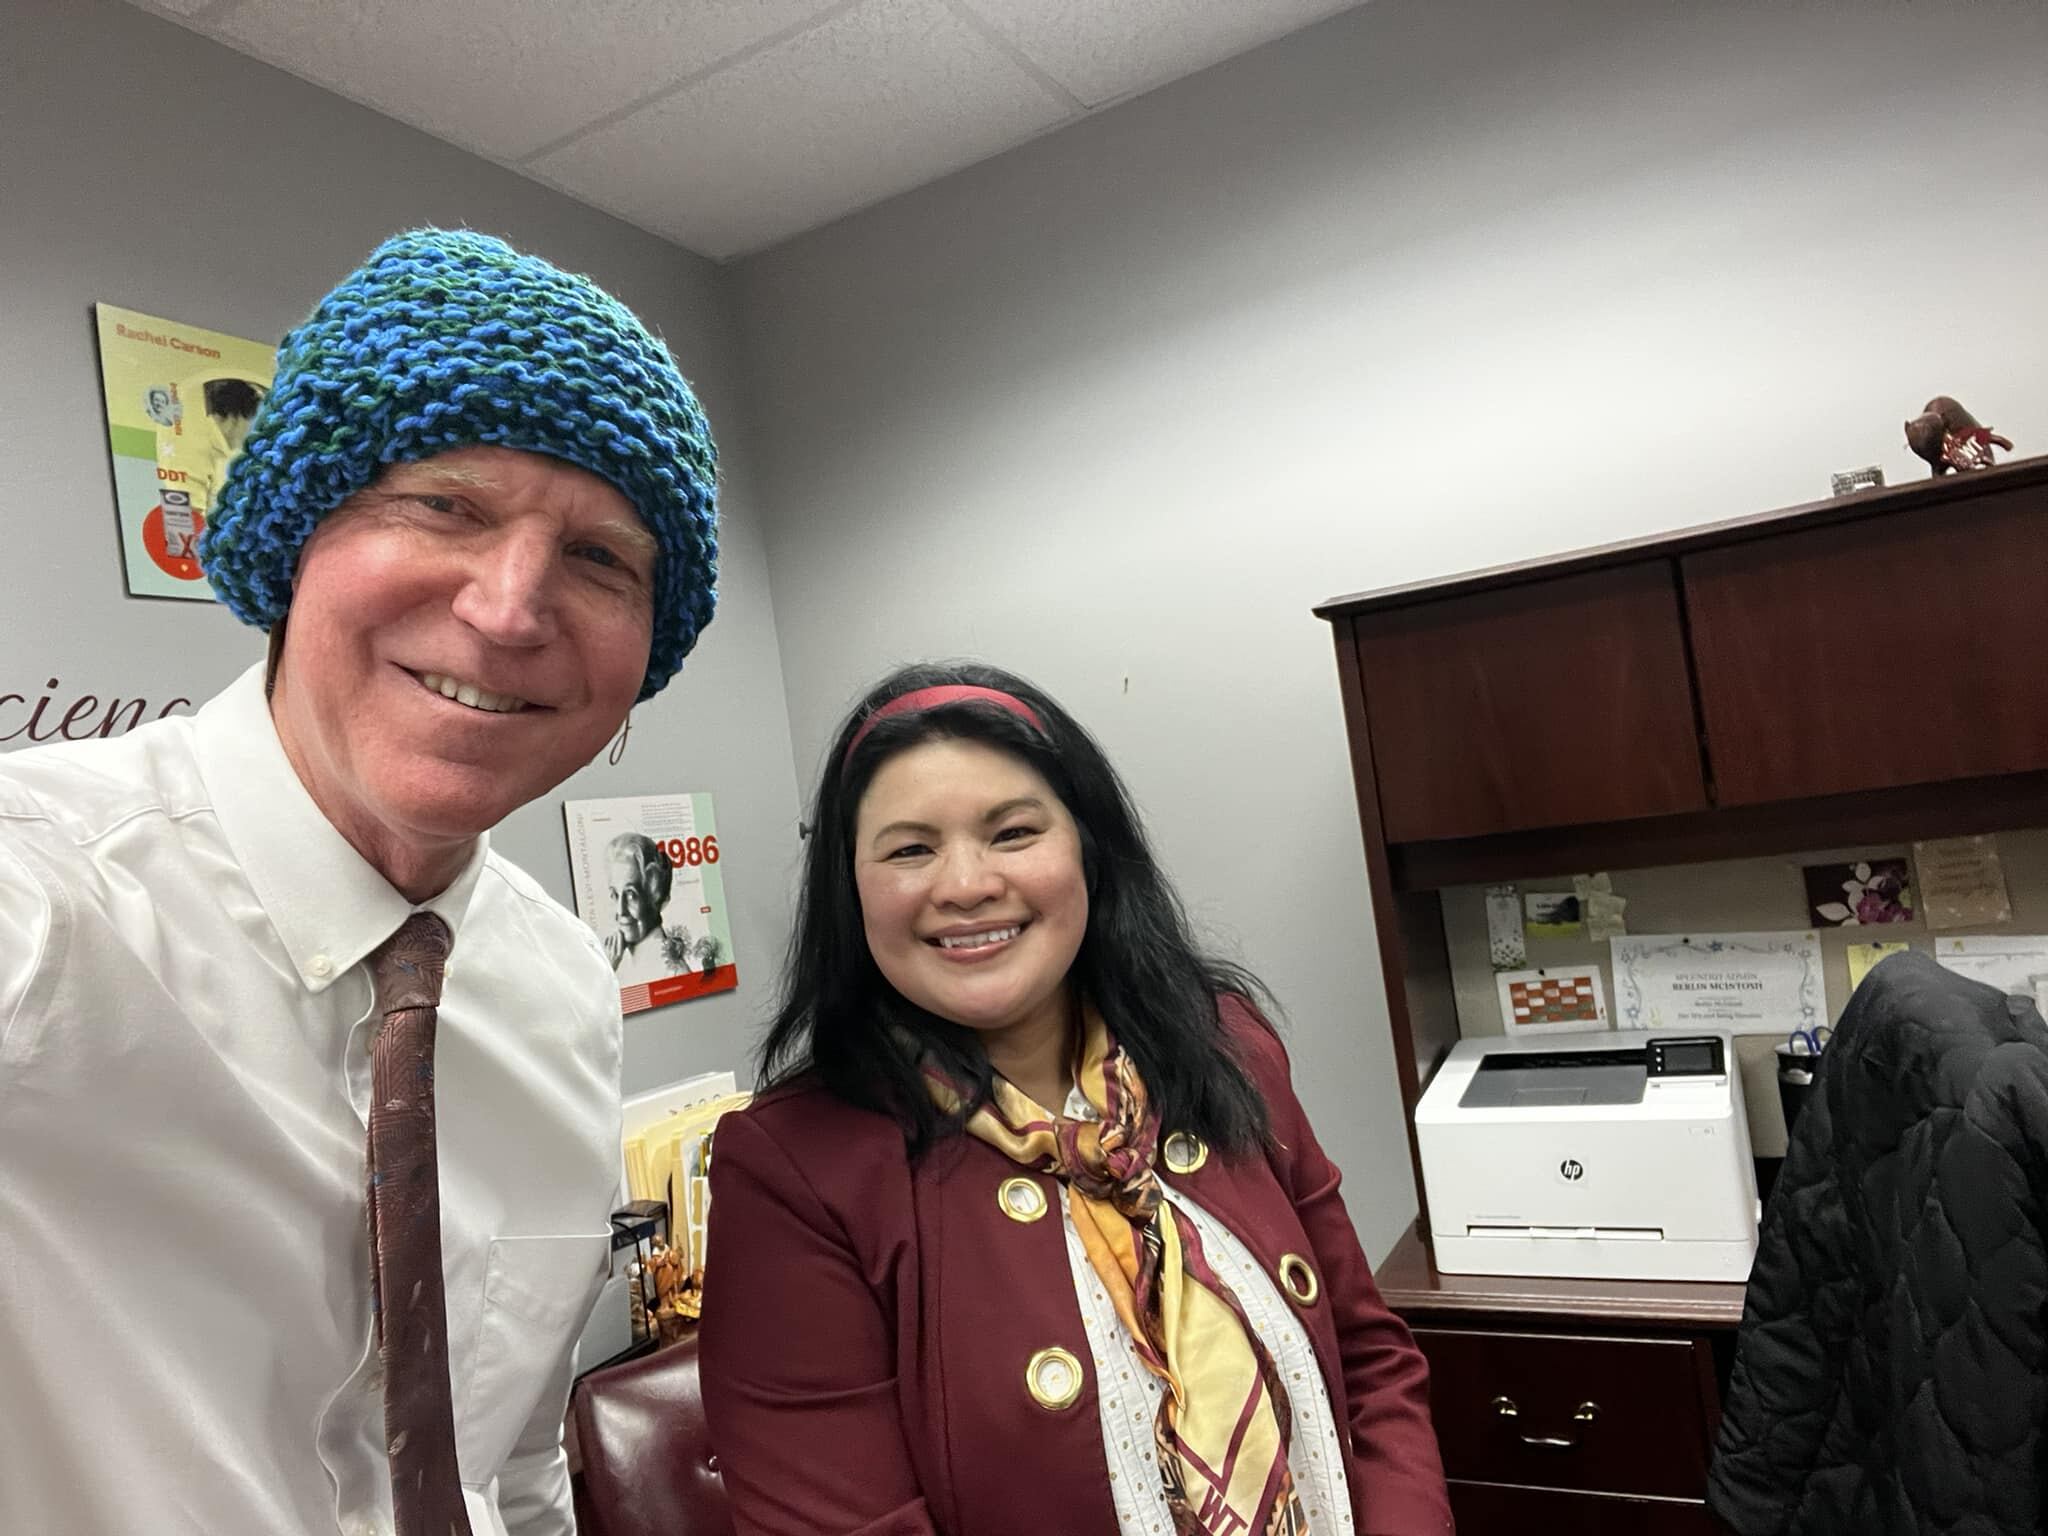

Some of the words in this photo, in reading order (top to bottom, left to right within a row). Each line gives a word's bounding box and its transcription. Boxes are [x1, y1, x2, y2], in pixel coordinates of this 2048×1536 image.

[116, 323, 167, 347] Rachel
[170, 338, 221, 359] Carson
[156, 467, 188, 483] DDT
[1560, 1159, 1584, 1182] hp
